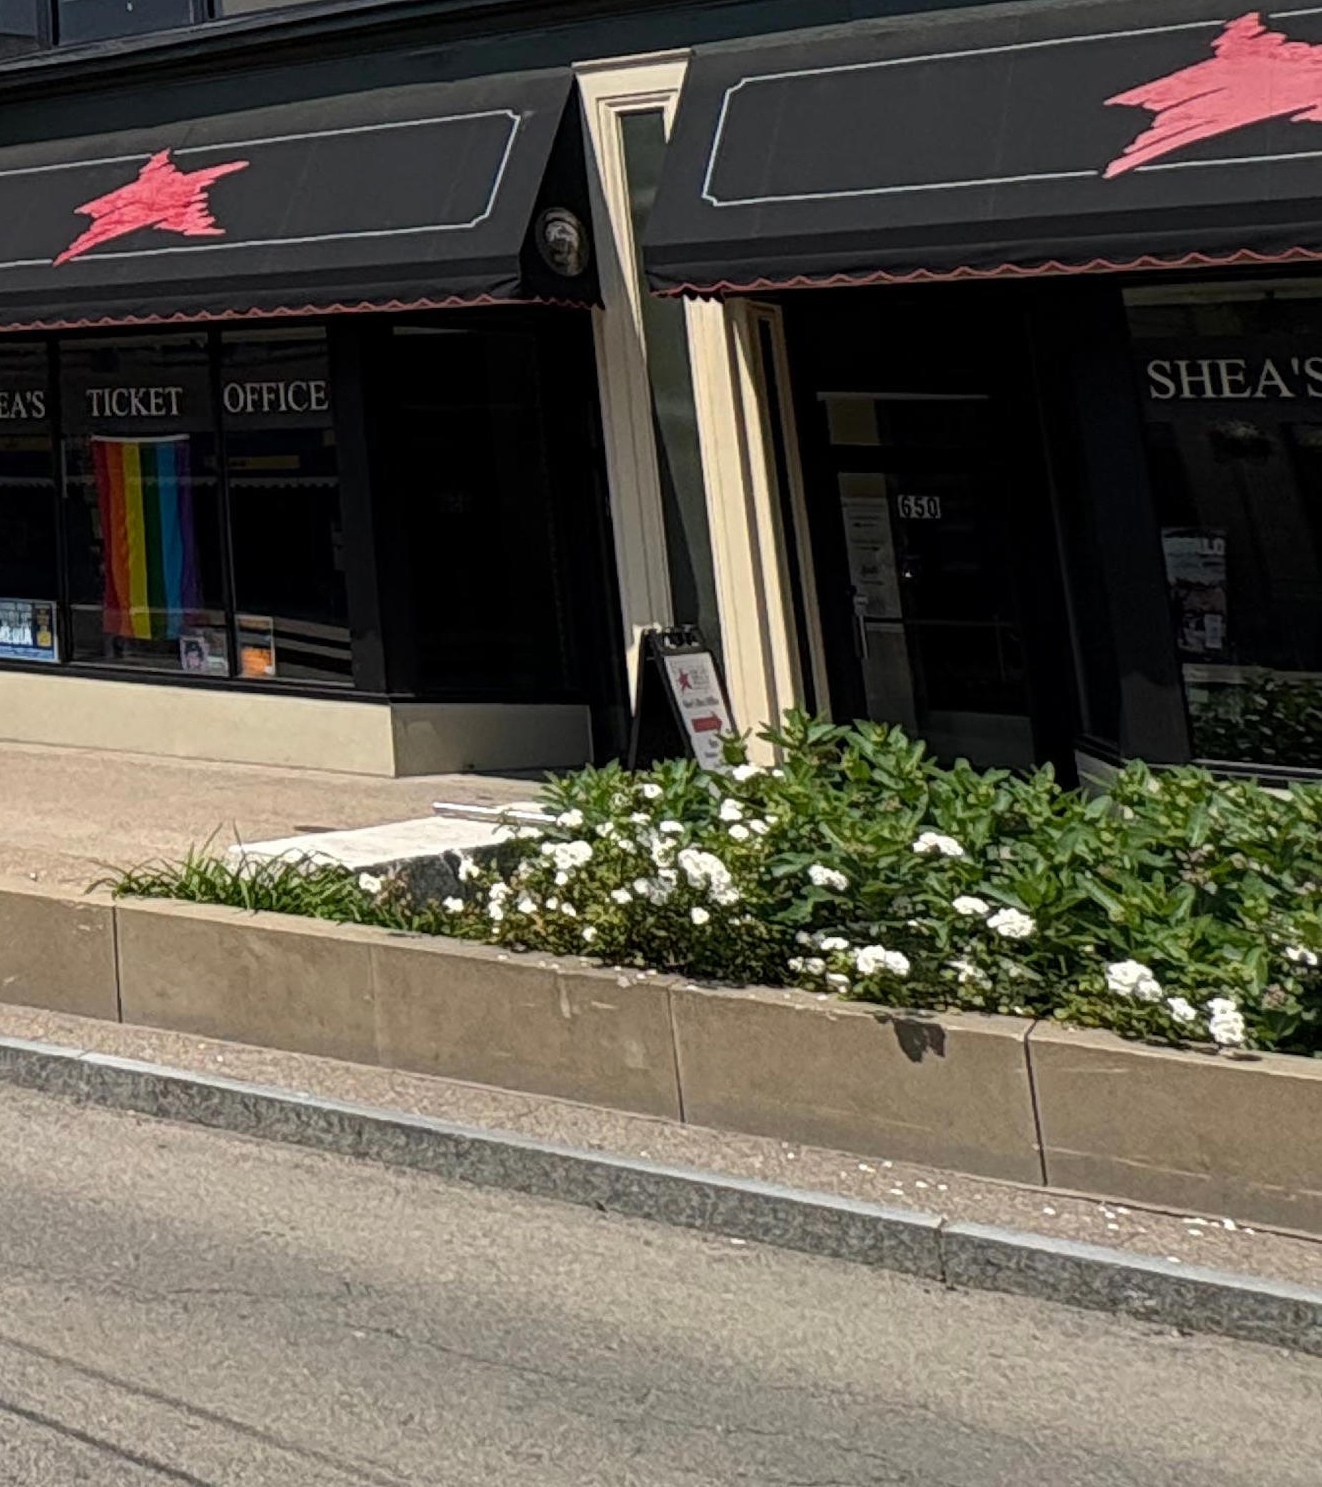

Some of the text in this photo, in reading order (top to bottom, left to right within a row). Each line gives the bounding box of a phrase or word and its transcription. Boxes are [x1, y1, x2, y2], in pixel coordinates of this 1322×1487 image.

[1146, 356, 1322, 400] SHEA'S
[86, 387, 184, 417] TICKET
[223, 380, 329, 413] OFFICE
[900, 497, 940, 518] 650
